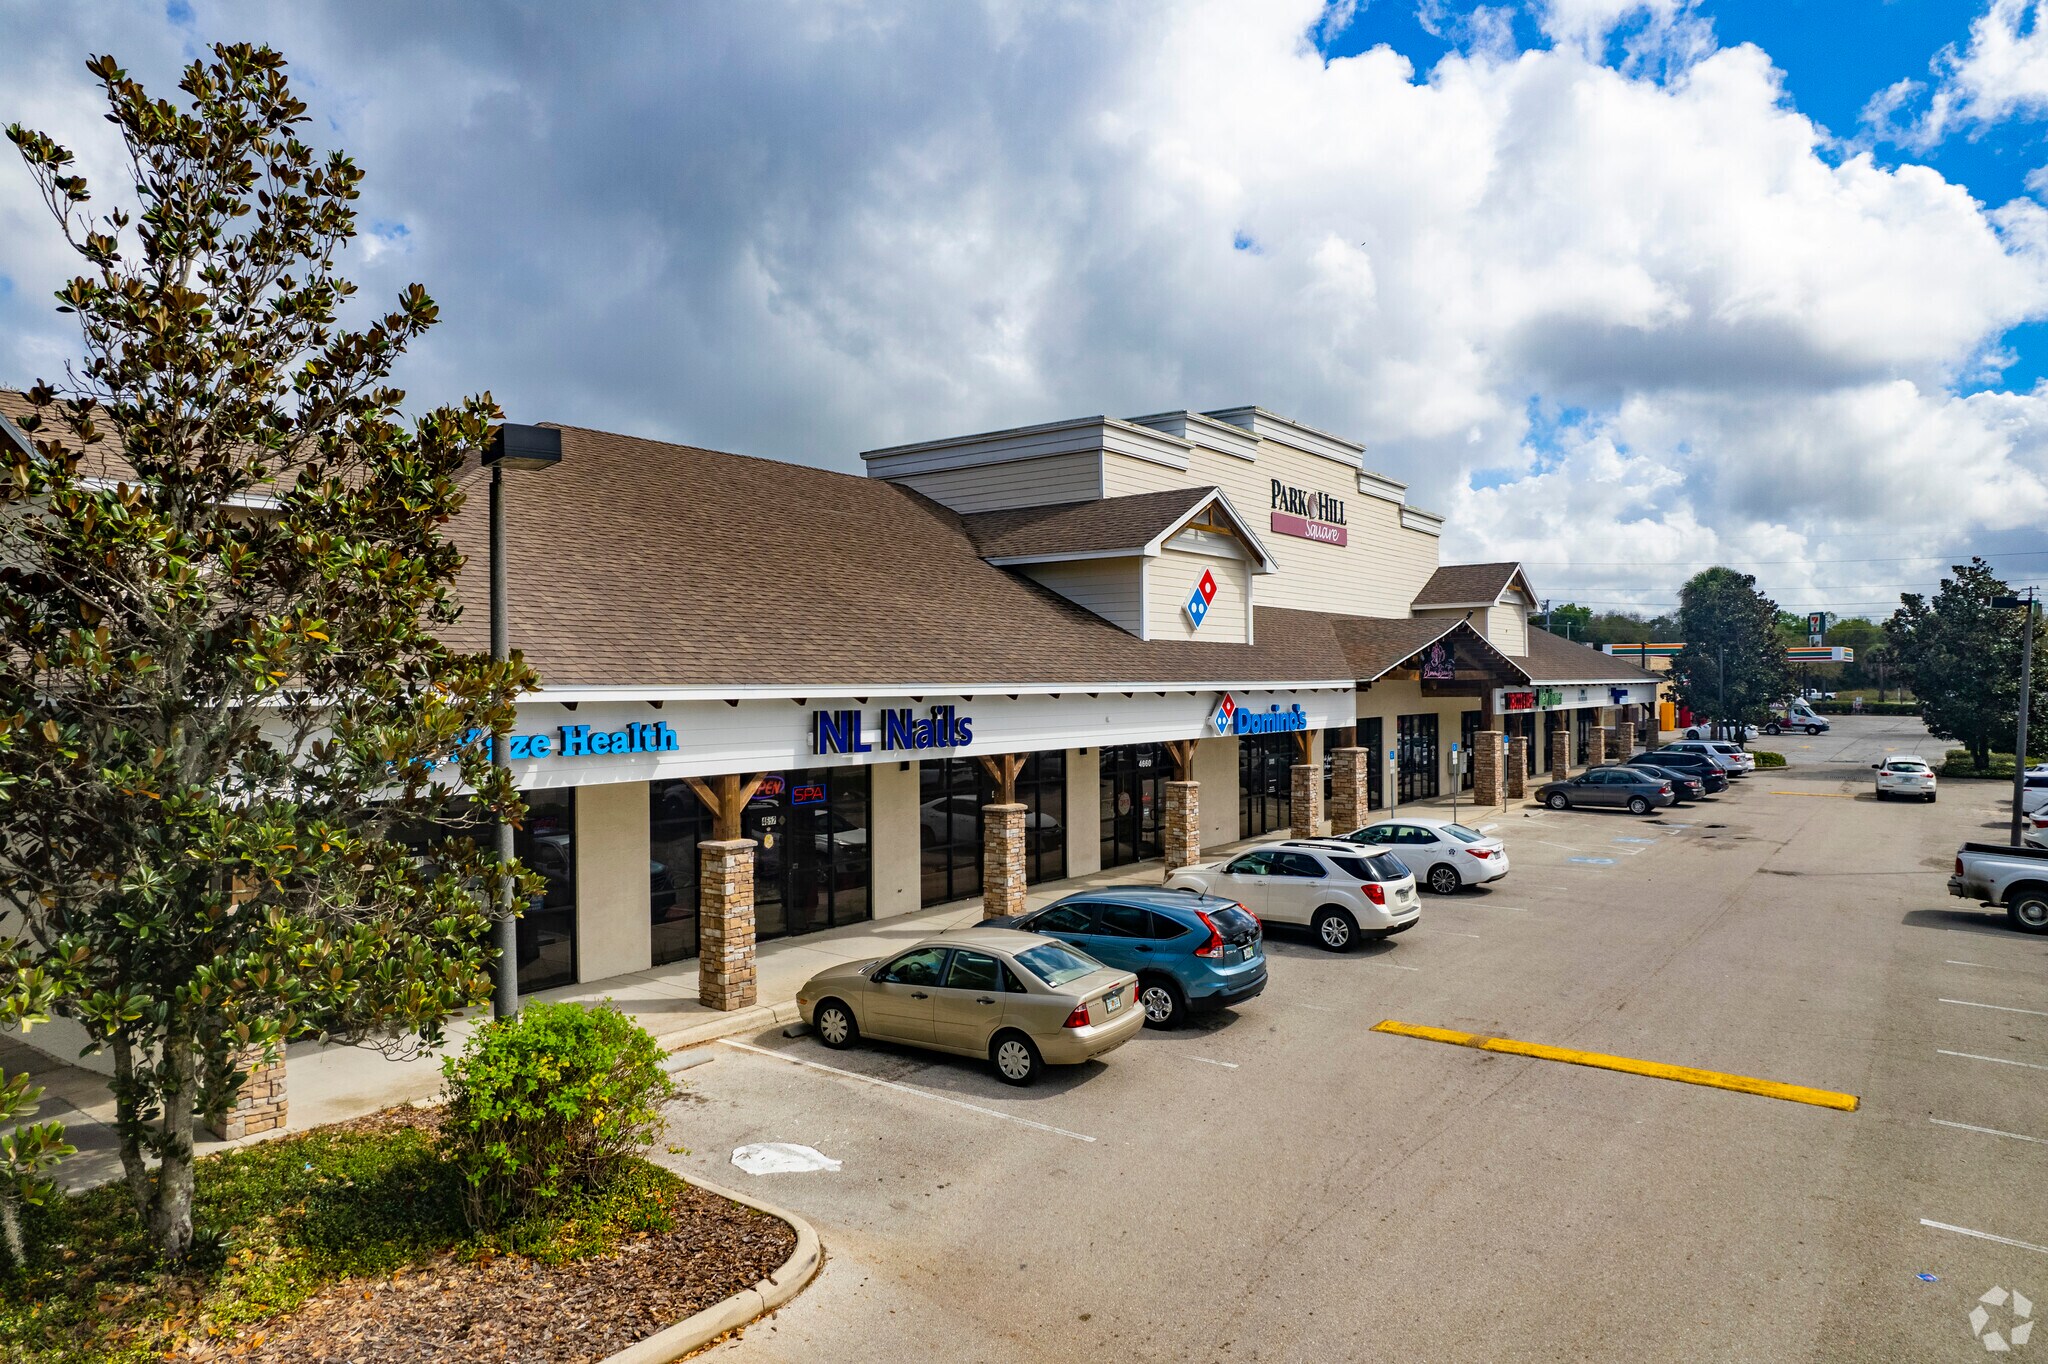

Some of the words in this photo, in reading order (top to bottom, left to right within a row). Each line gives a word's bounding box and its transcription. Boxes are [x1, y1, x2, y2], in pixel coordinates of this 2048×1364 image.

[1270, 478, 1308, 516] PARK
[1317, 491, 1347, 525] HILL
[1305, 520, 1340, 542] Square
[813, 709, 872, 755] NL
[880, 704, 974, 751] Nails
[1233, 703, 1307, 735] Domino's
[557, 720, 680, 757] Health
[755, 781, 781, 796] PEN
[794, 787, 823, 802] SPA
